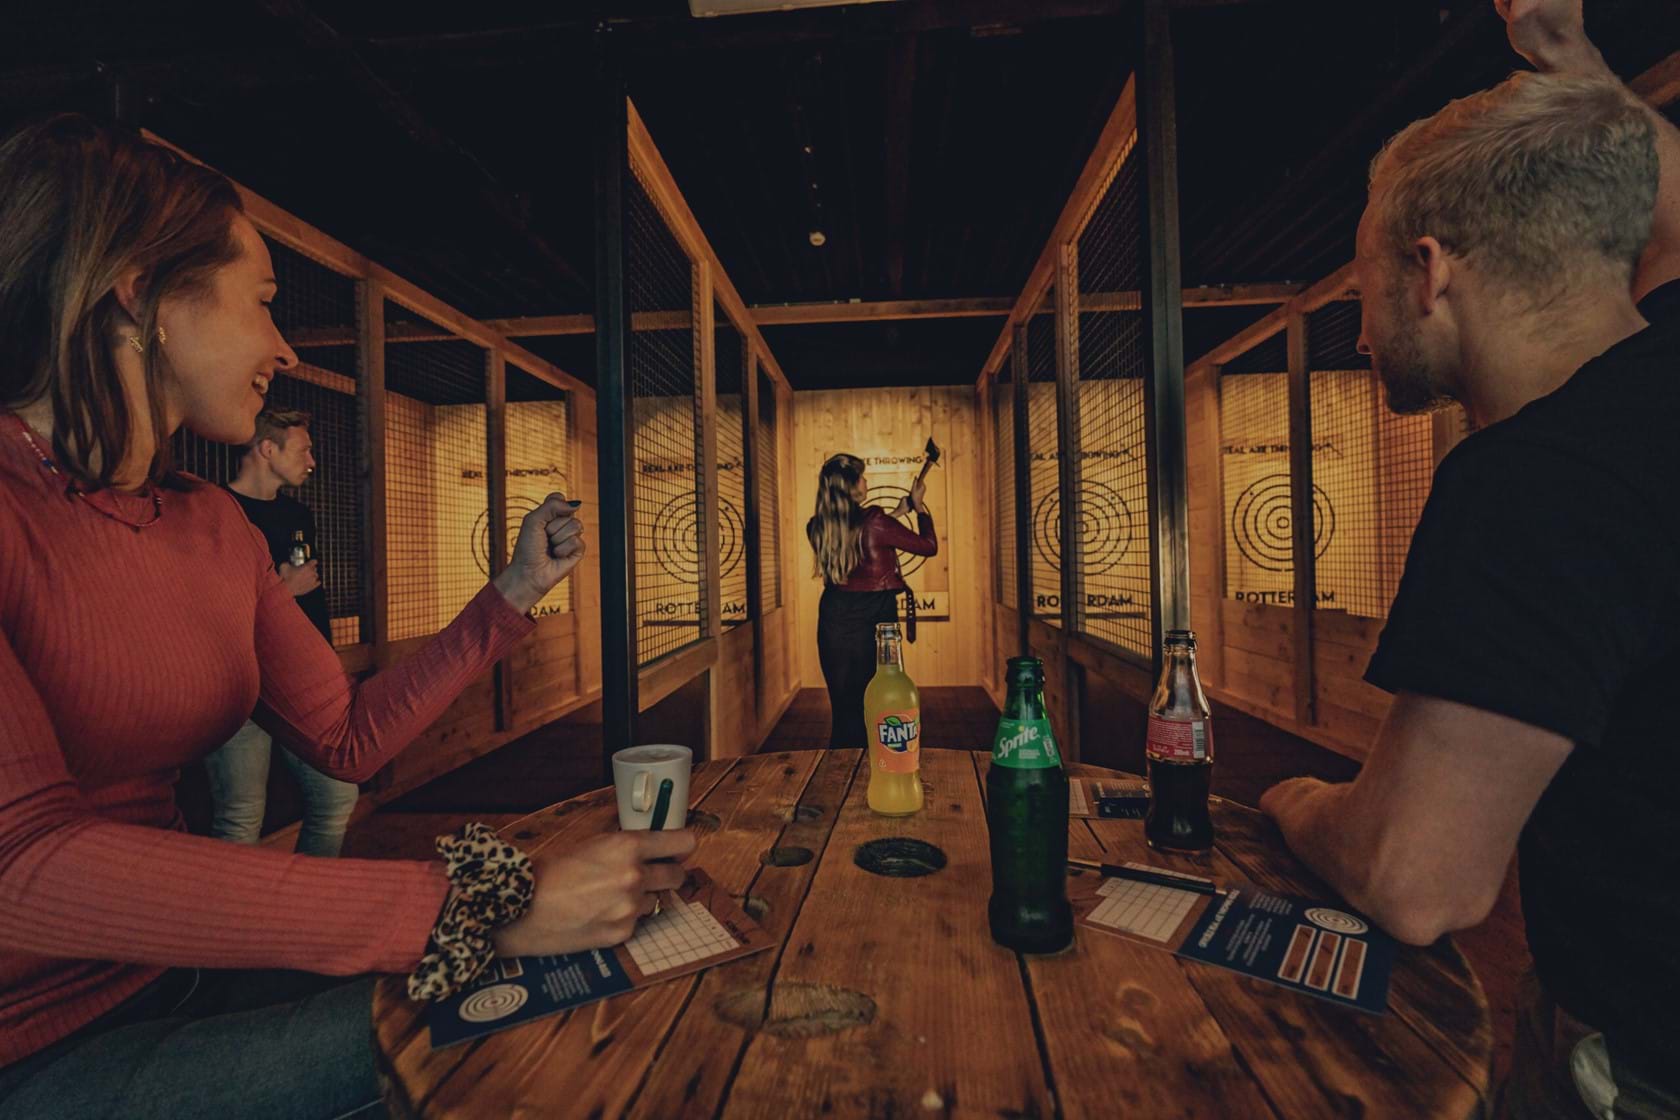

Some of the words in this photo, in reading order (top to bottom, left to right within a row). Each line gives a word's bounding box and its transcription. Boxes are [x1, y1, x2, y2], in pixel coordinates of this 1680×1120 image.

[874, 456, 923, 465] THROWING
[1037, 594, 1133, 607] RORDAM
[1235, 591, 1335, 605] ROTTERM
[655, 602, 746, 615] ROTTEAM
[998, 725, 1041, 759] Sprite
